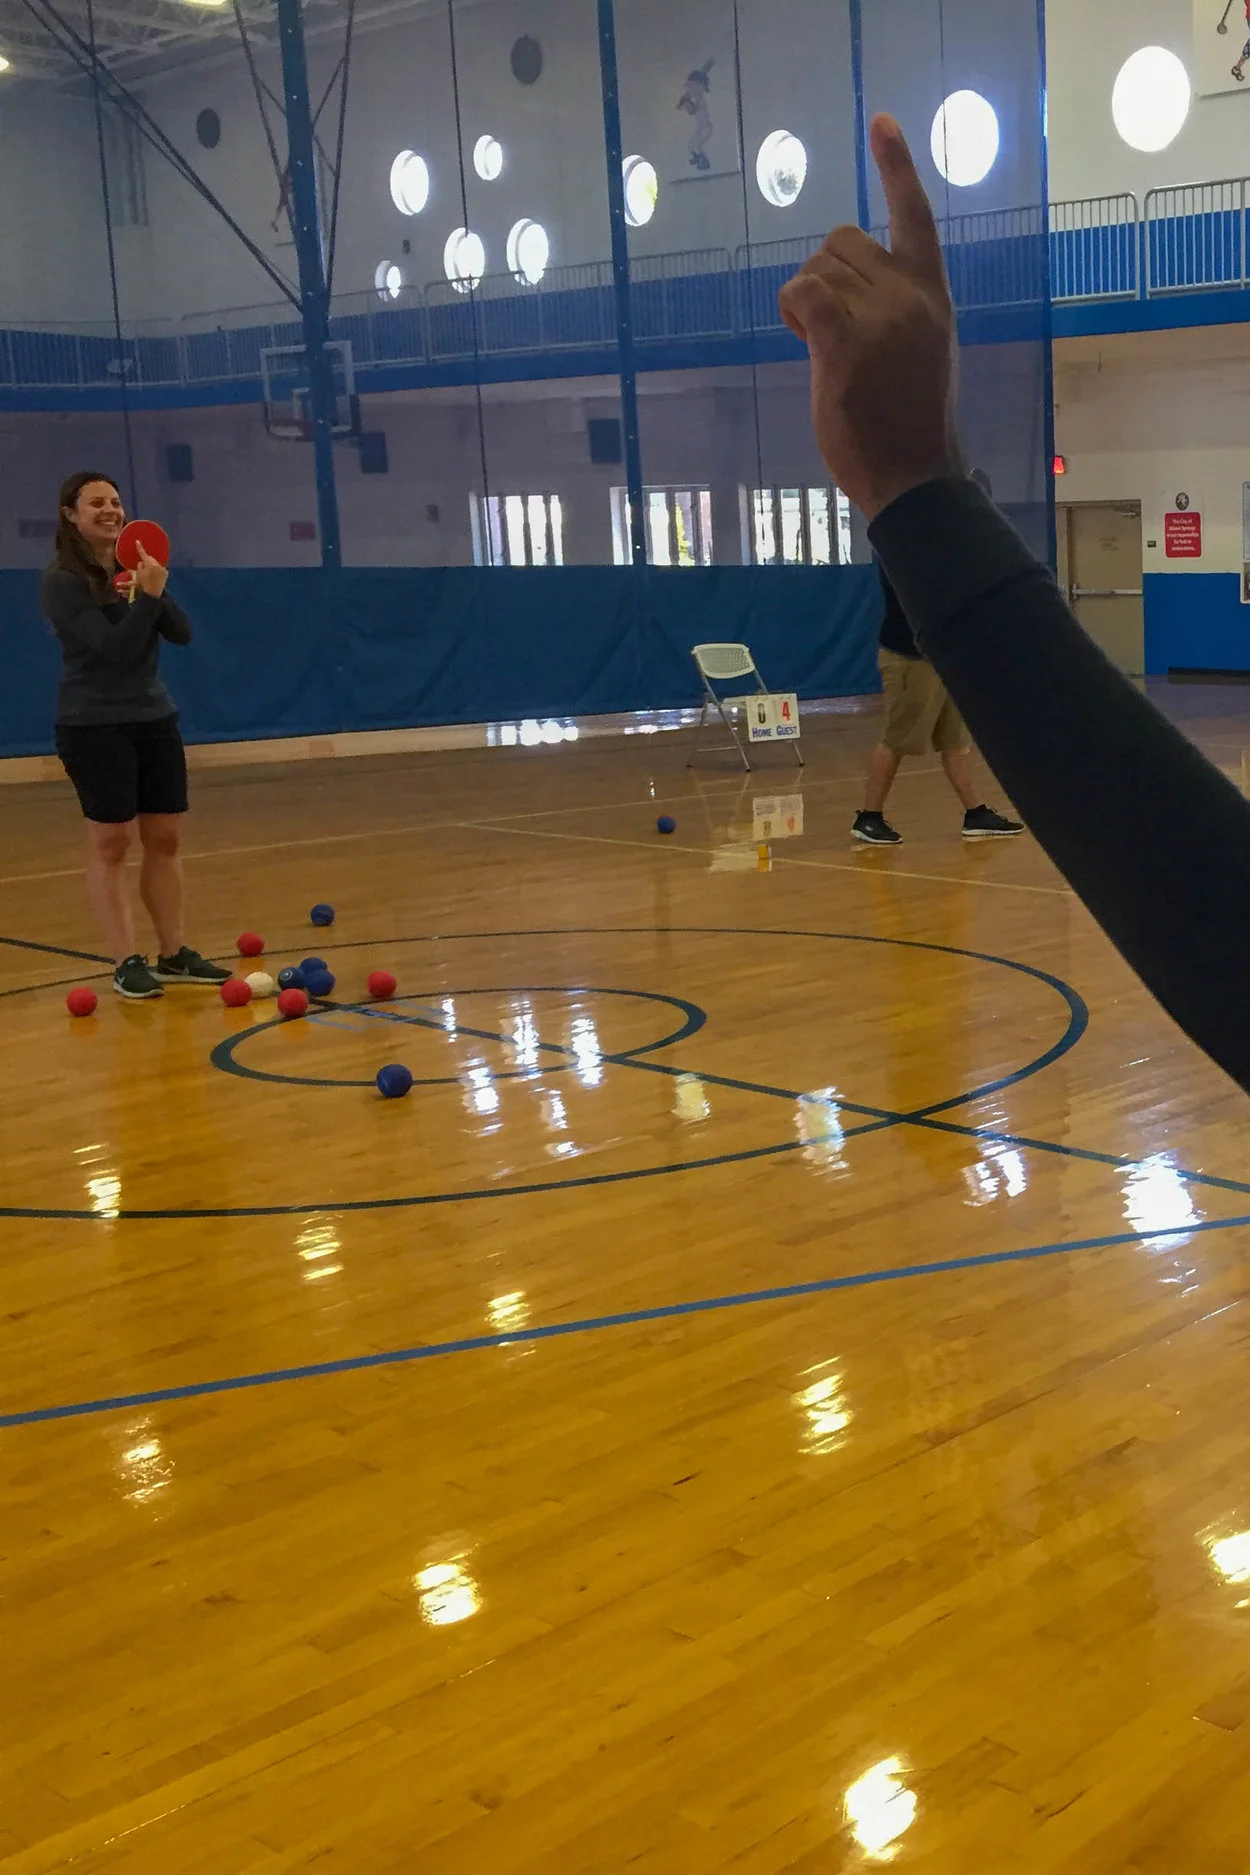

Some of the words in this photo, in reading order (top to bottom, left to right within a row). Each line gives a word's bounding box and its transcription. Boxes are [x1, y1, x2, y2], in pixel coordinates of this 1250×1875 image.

[782, 701, 791, 722] 4
[752, 727, 772, 738] HOME
[777, 725, 797, 736] GUEST
